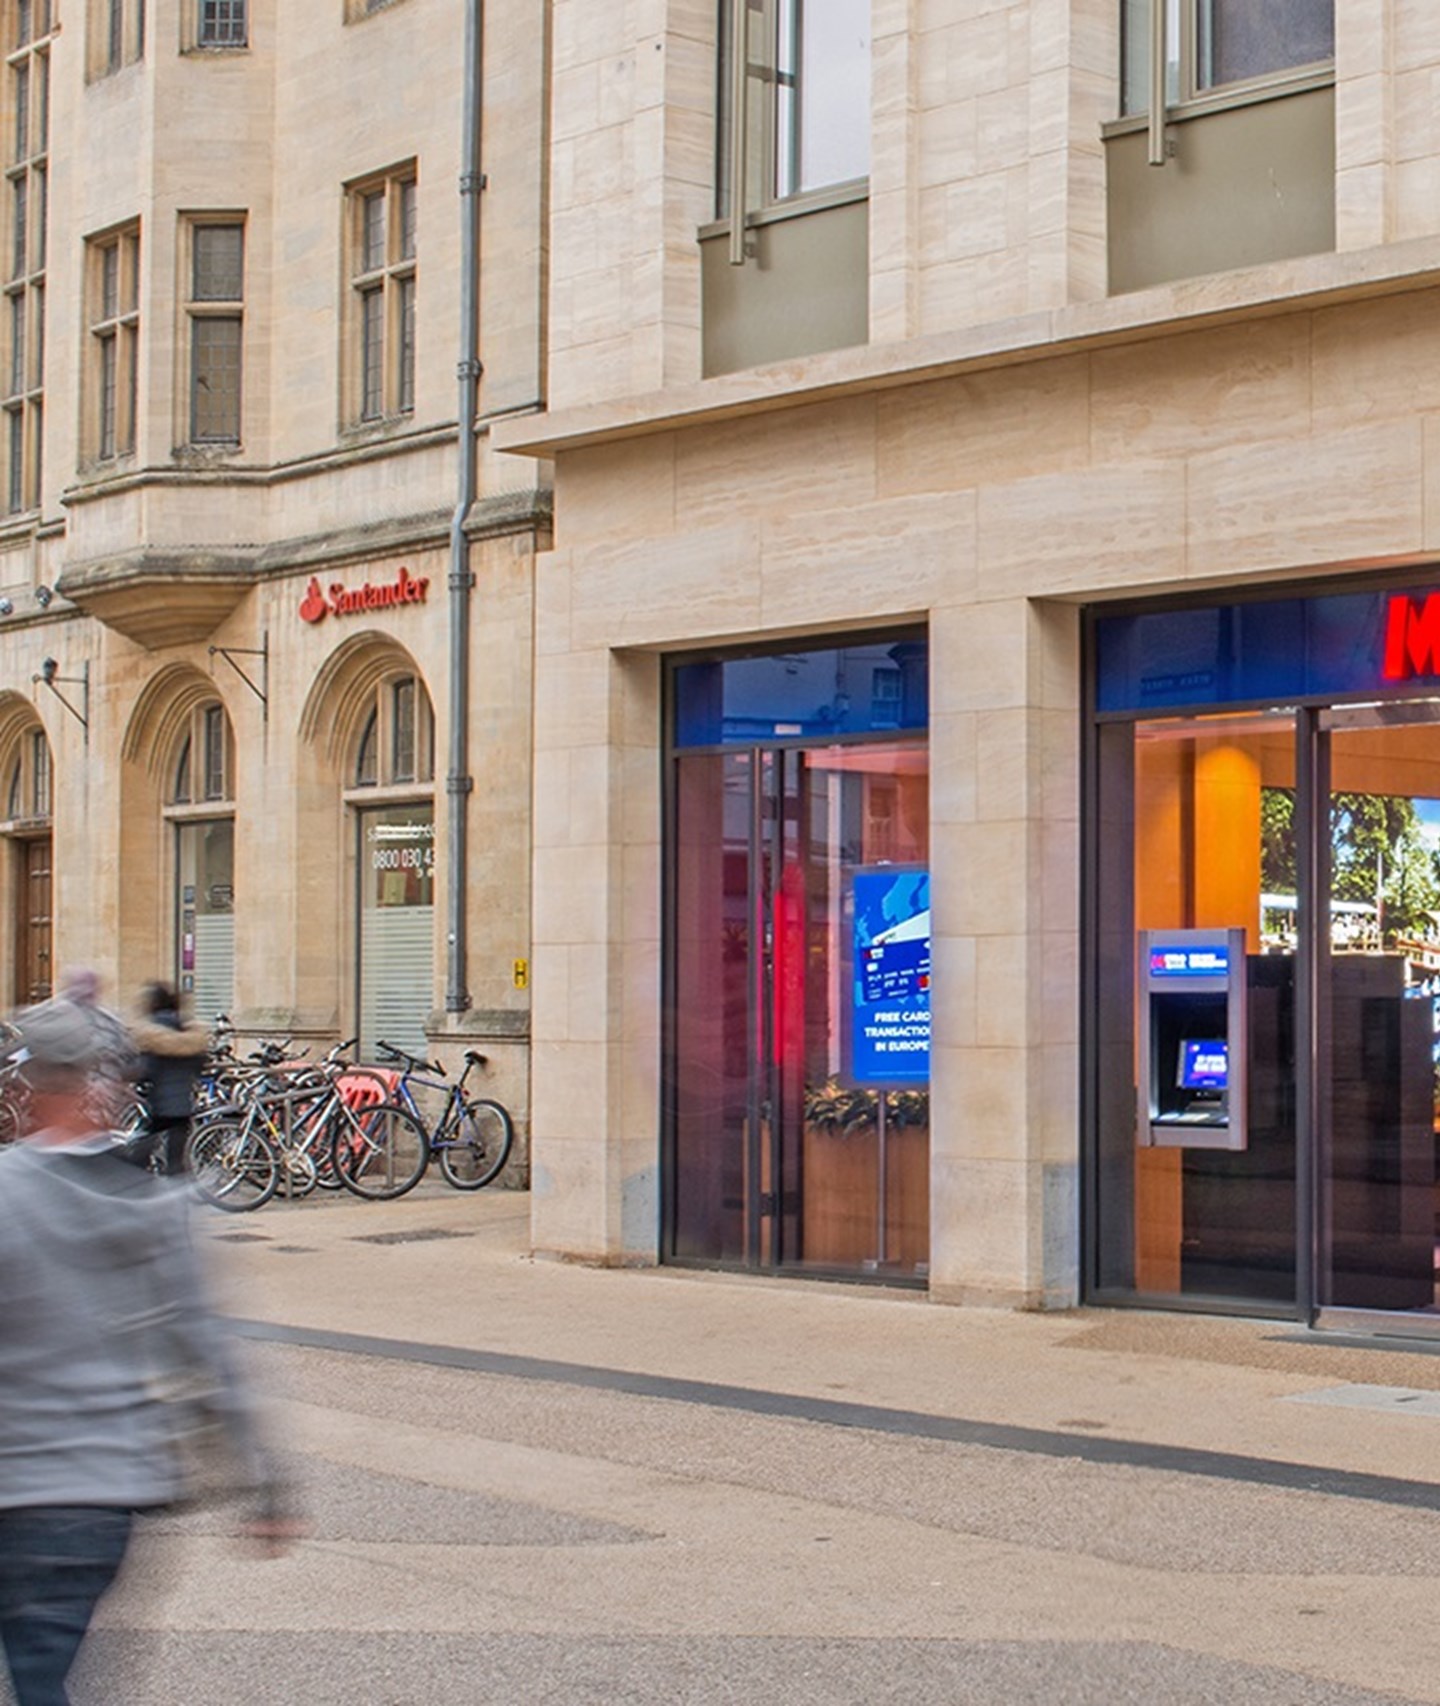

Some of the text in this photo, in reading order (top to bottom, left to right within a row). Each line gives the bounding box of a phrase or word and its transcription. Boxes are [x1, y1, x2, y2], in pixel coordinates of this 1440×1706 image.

[329, 567, 429, 616] Santander
[372, 849, 399, 869] 0800
[401, 848, 422, 868] 030
[874, 1011, 900, 1023] FREE
[864, 1025, 931, 1038] TRANSACTIO
